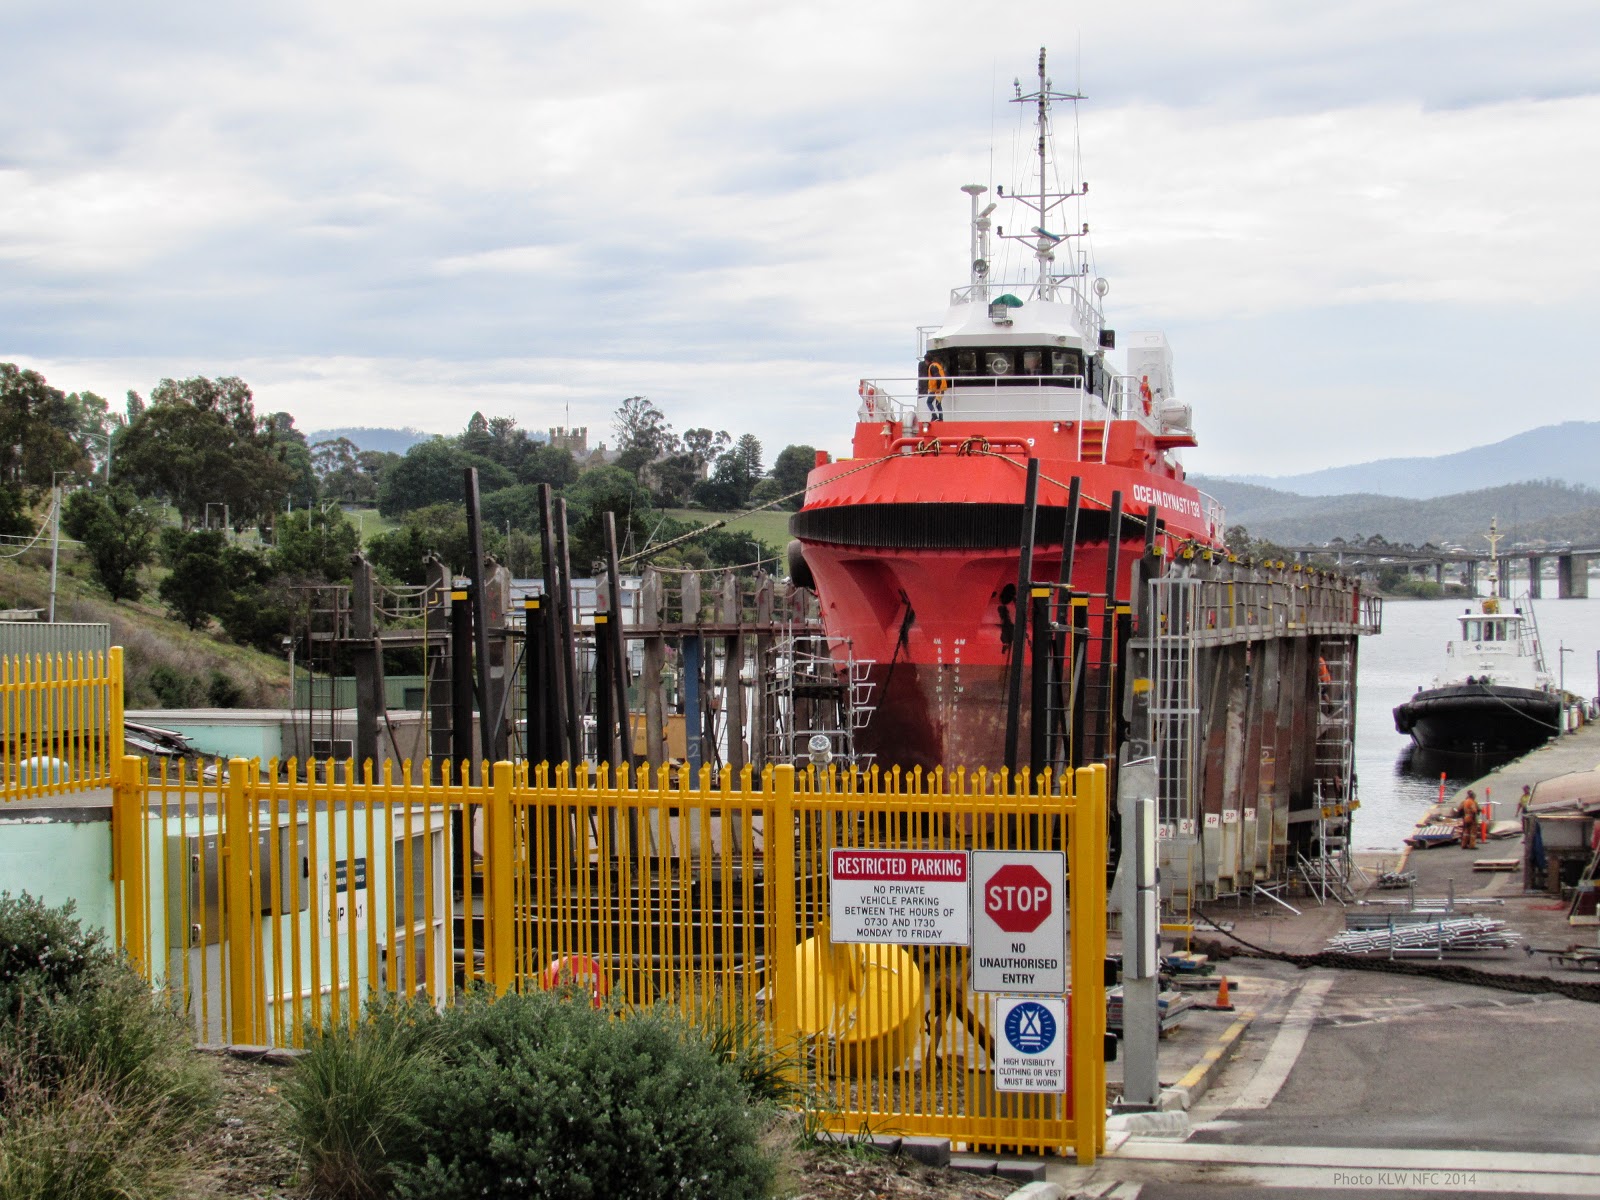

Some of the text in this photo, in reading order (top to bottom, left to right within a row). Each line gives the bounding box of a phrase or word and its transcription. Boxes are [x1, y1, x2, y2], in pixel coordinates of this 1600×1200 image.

[1133, 484, 1162, 506] OCEAN
[1162, 491, 1190, 515] DYNASTY
[687, 743, 700, 758] 2
[1207, 816, 1217, 825] 4P
[1225, 812, 1235, 820] 5P
[837, 857, 962, 876] RESTRICTED PARKING
[873, 885, 925, 895] NO PRIVATE
[860, 896, 940, 906] VEHICLE PARKING
[988, 885, 1048, 912] STOP
[327, 907, 345, 922] SIP
[844, 906, 955, 918] BETWEEN THE HOURS OF
[864, 917, 936, 928] 0730 AND 1730
[856, 928, 943, 939] MONDAY TO FRIDAY
[1011, 943, 1026, 953] NO
[980, 957, 1058, 969] UNAUTHORISED
[1002, 973, 1035, 984] ENTRY
[1003, 1058, 1056, 1067] HIGH VISIBILITY
[999, 1067, 1062, 1077] CLOTHING OR VEST
[1004, 1077, 1057, 1087] MUST BE WORN
